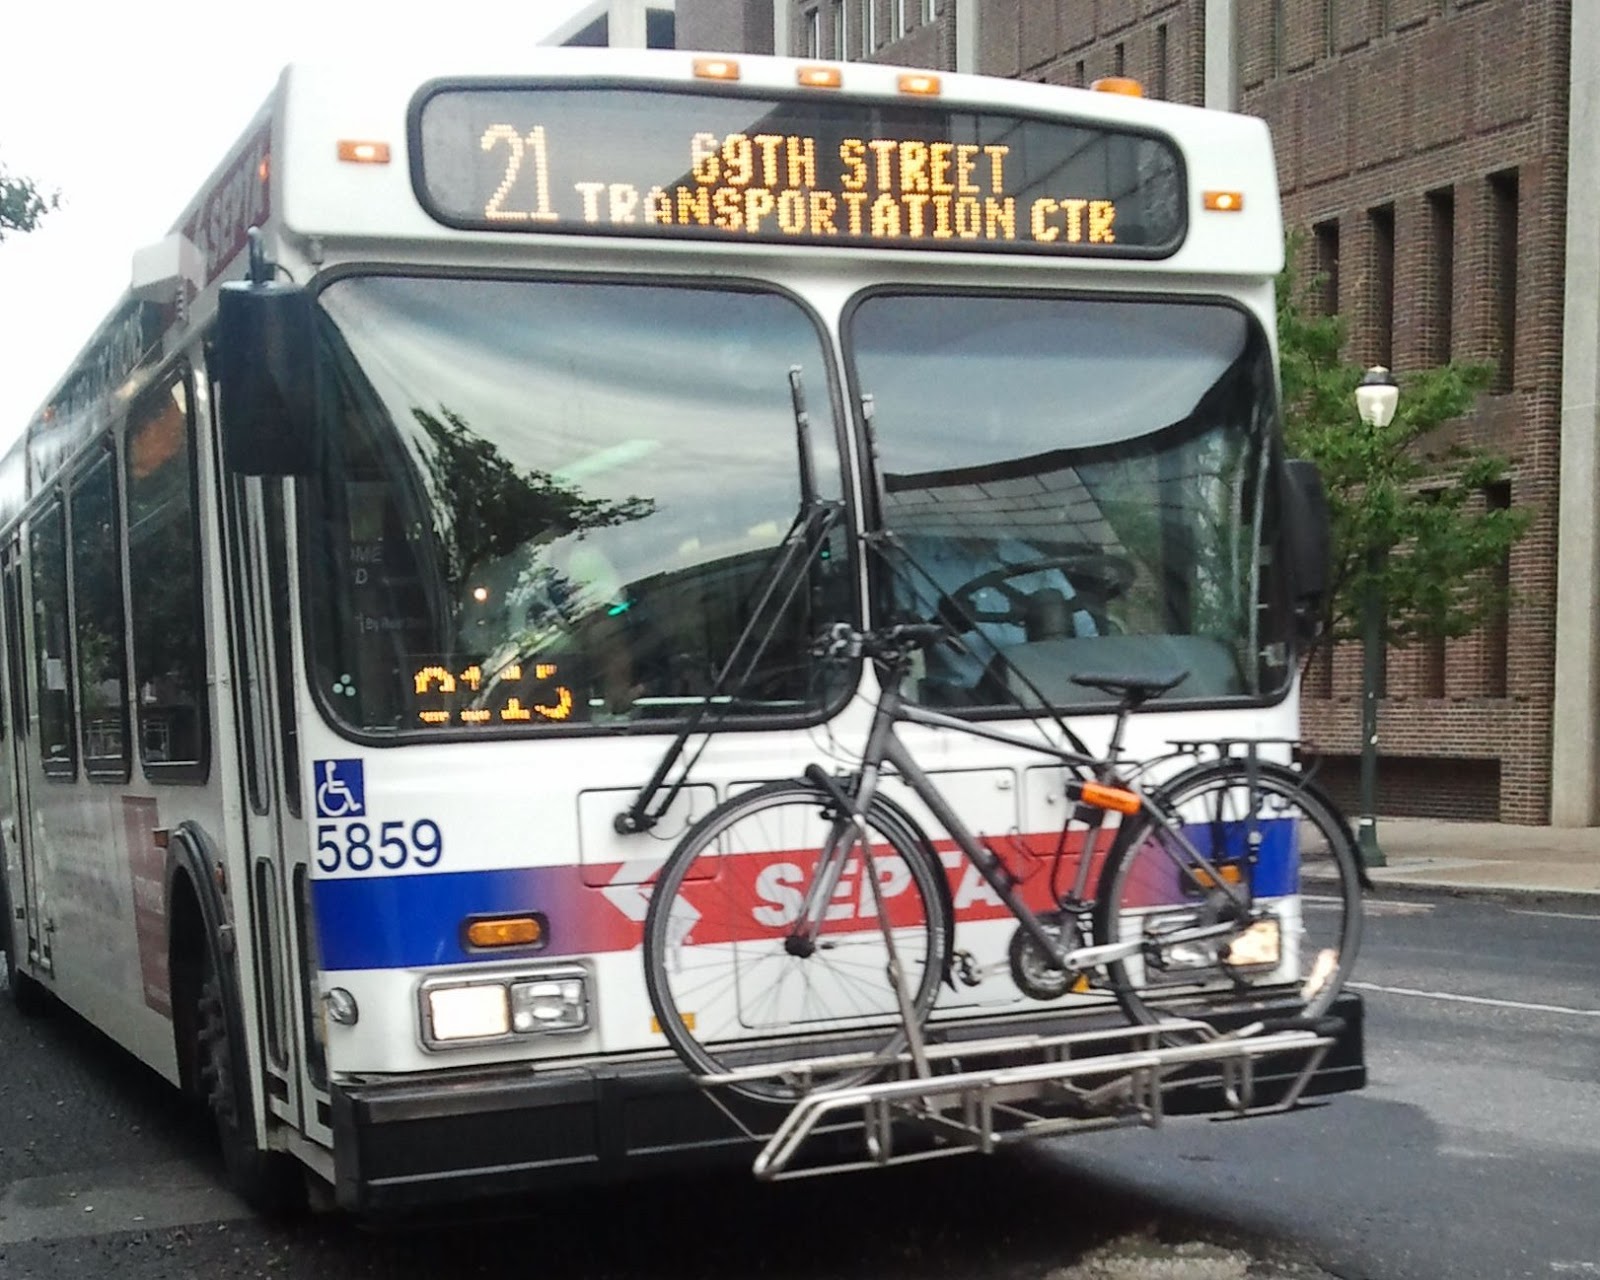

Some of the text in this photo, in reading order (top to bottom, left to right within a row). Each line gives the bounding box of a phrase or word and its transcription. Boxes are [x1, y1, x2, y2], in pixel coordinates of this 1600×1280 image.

[480, 123, 560, 222] 21
[690, 132, 1010, 195] 69TH STREET
[574, 180, 1117, 245] TRANSPORTATION CTR
[317, 818, 443, 873] 5859
